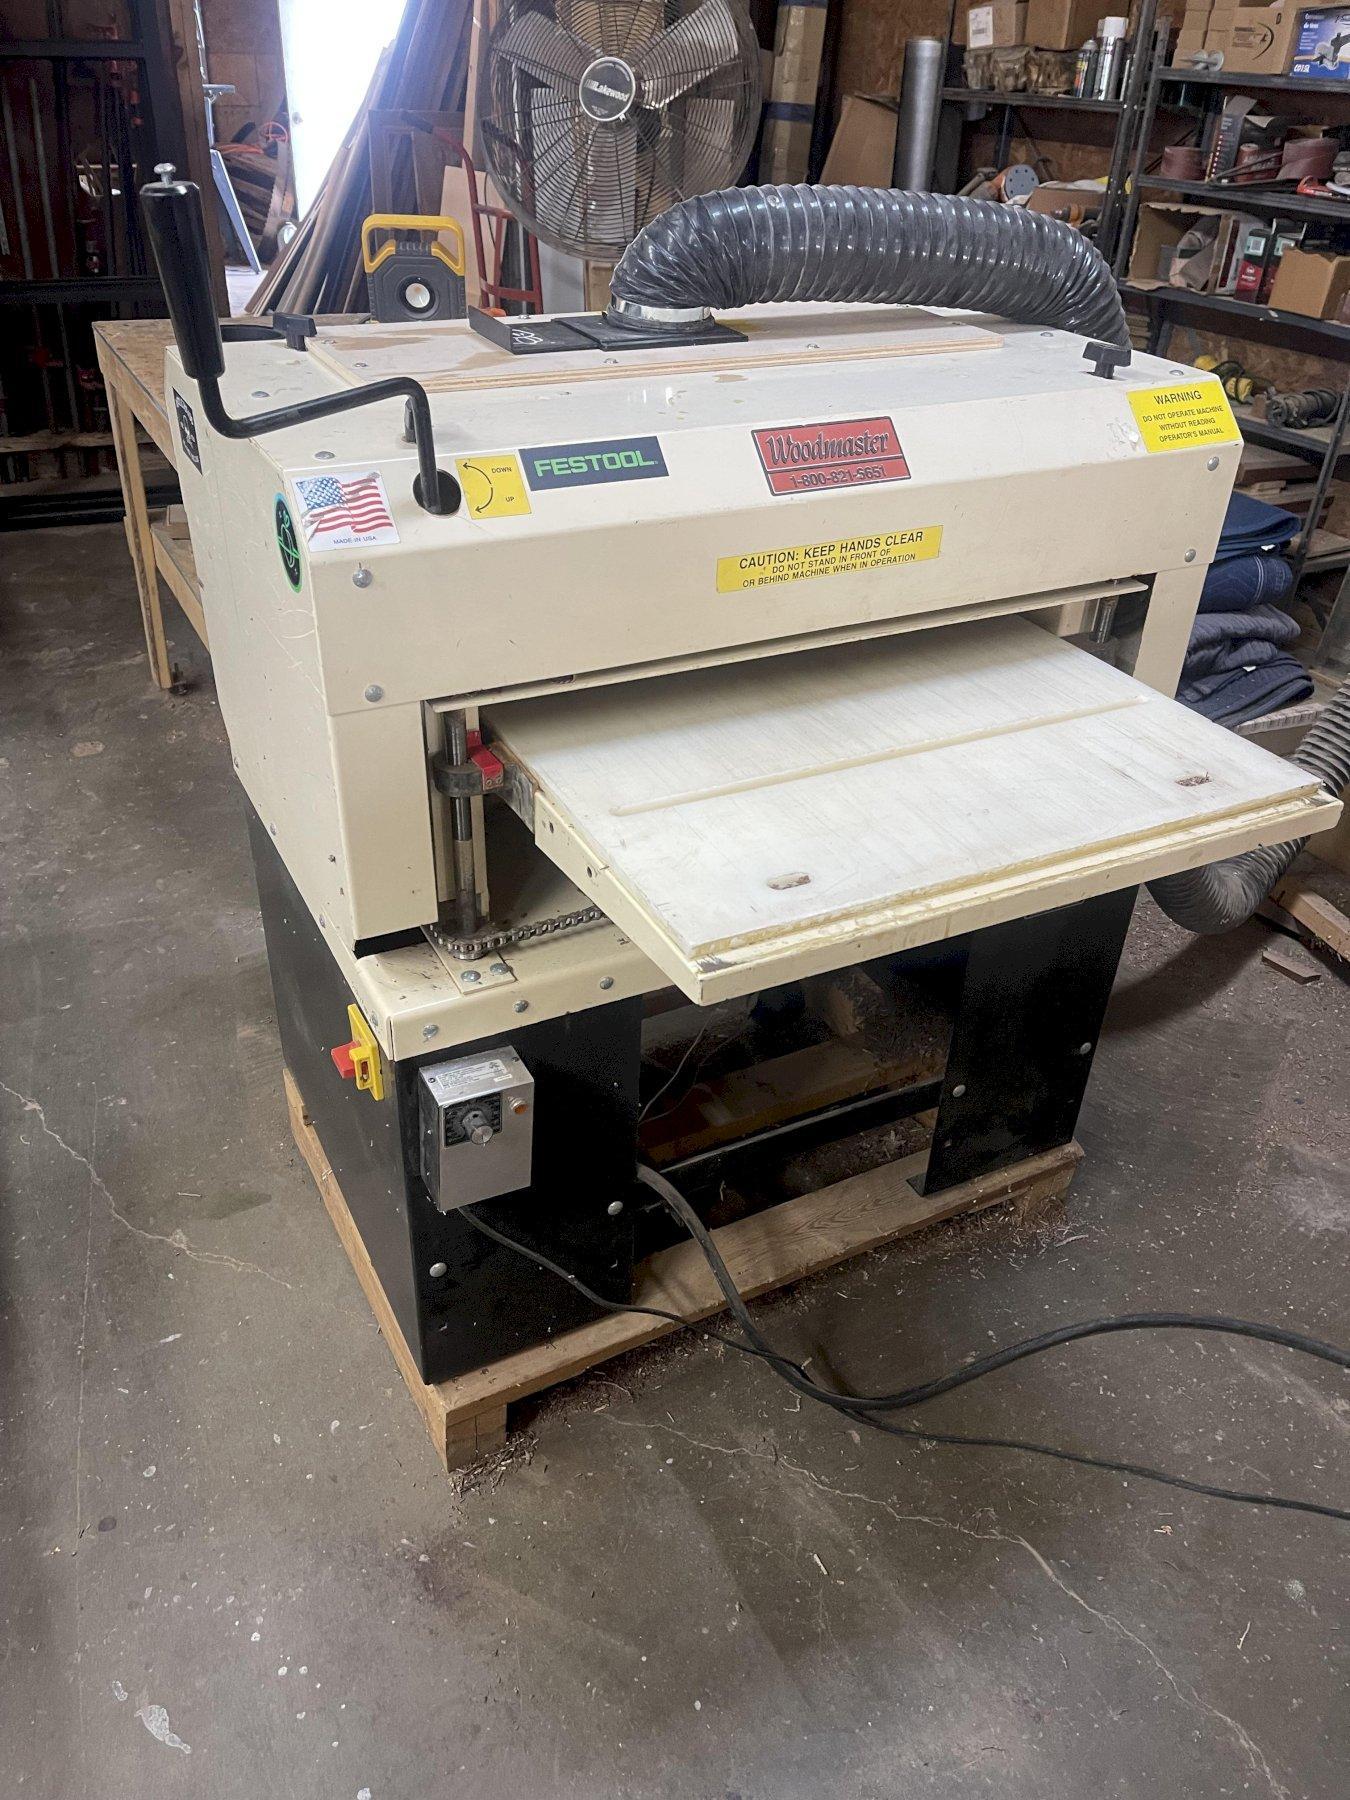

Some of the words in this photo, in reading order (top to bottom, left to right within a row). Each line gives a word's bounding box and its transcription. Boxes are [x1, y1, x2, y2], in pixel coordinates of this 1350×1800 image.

[594, 81, 630, 102] Lakewood
[1154, 390, 1202, 405] WARNING
[1153, 413, 1166, 421] NOT
[1167, 409, 1196, 419] OPERATE
[1196, 405, 1224, 415] MACHINE
[1159, 421, 1187, 431] WITHOUT
[1188, 417, 1216, 427] READING
[1159, 431, 1198, 442] OPERATOR'S
[1198, 427, 1224, 437] MANUAL
[766, 429, 889, 465] Woodmaster
[491, 466, 513, 474] DOWN
[534, 450, 655, 477] FESTOOL
[739, 550, 800, 570] CAUTION:
[803, 544, 836, 559] KEEP
[839, 537, 881, 554] HANDS
[885, 531, 924, 546] CLEAR
[772, 564, 785, 574] DO
[787, 561, 806, 571] NOT
[808, 556, 837, 568] STAND
[839, 555, 848, 563] IN
[850, 550, 877, 561] FRONT
[880, 548, 891, 557] OF
[742, 578, 755, 588] OR
[757, 573, 789, 586] BEHIND
[792, 567, 830, 580] MACHINE
[833, 562, 857, 573] WHEN
[859, 560, 868, 569] IN
[870, 553, 916, 567] OPERATION
